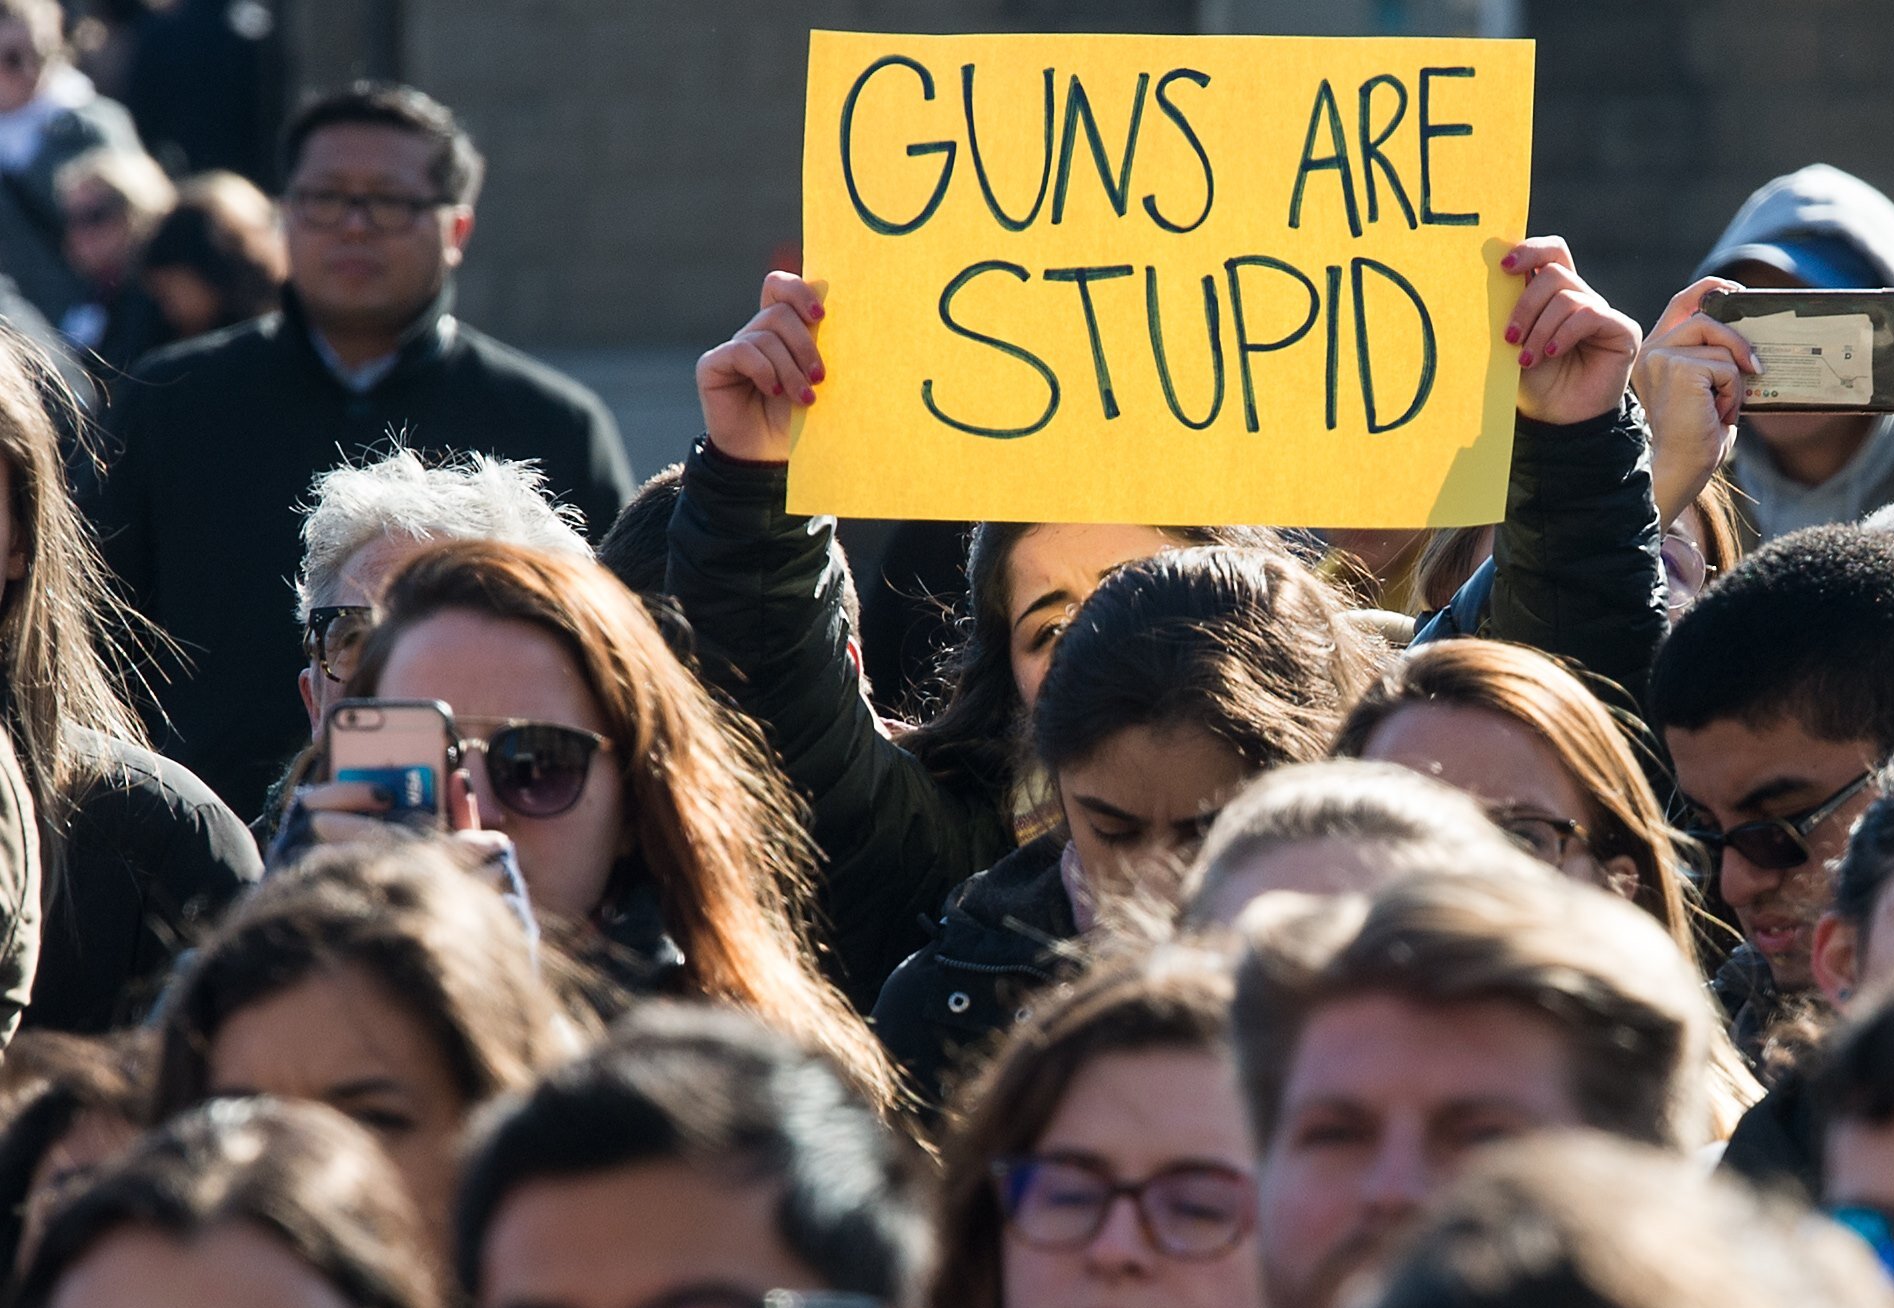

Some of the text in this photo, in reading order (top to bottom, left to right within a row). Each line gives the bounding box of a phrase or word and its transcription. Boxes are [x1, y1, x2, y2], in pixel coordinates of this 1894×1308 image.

[840, 55, 1480, 239] GUNS ARE
[922, 255, 1437, 440] STUPID
